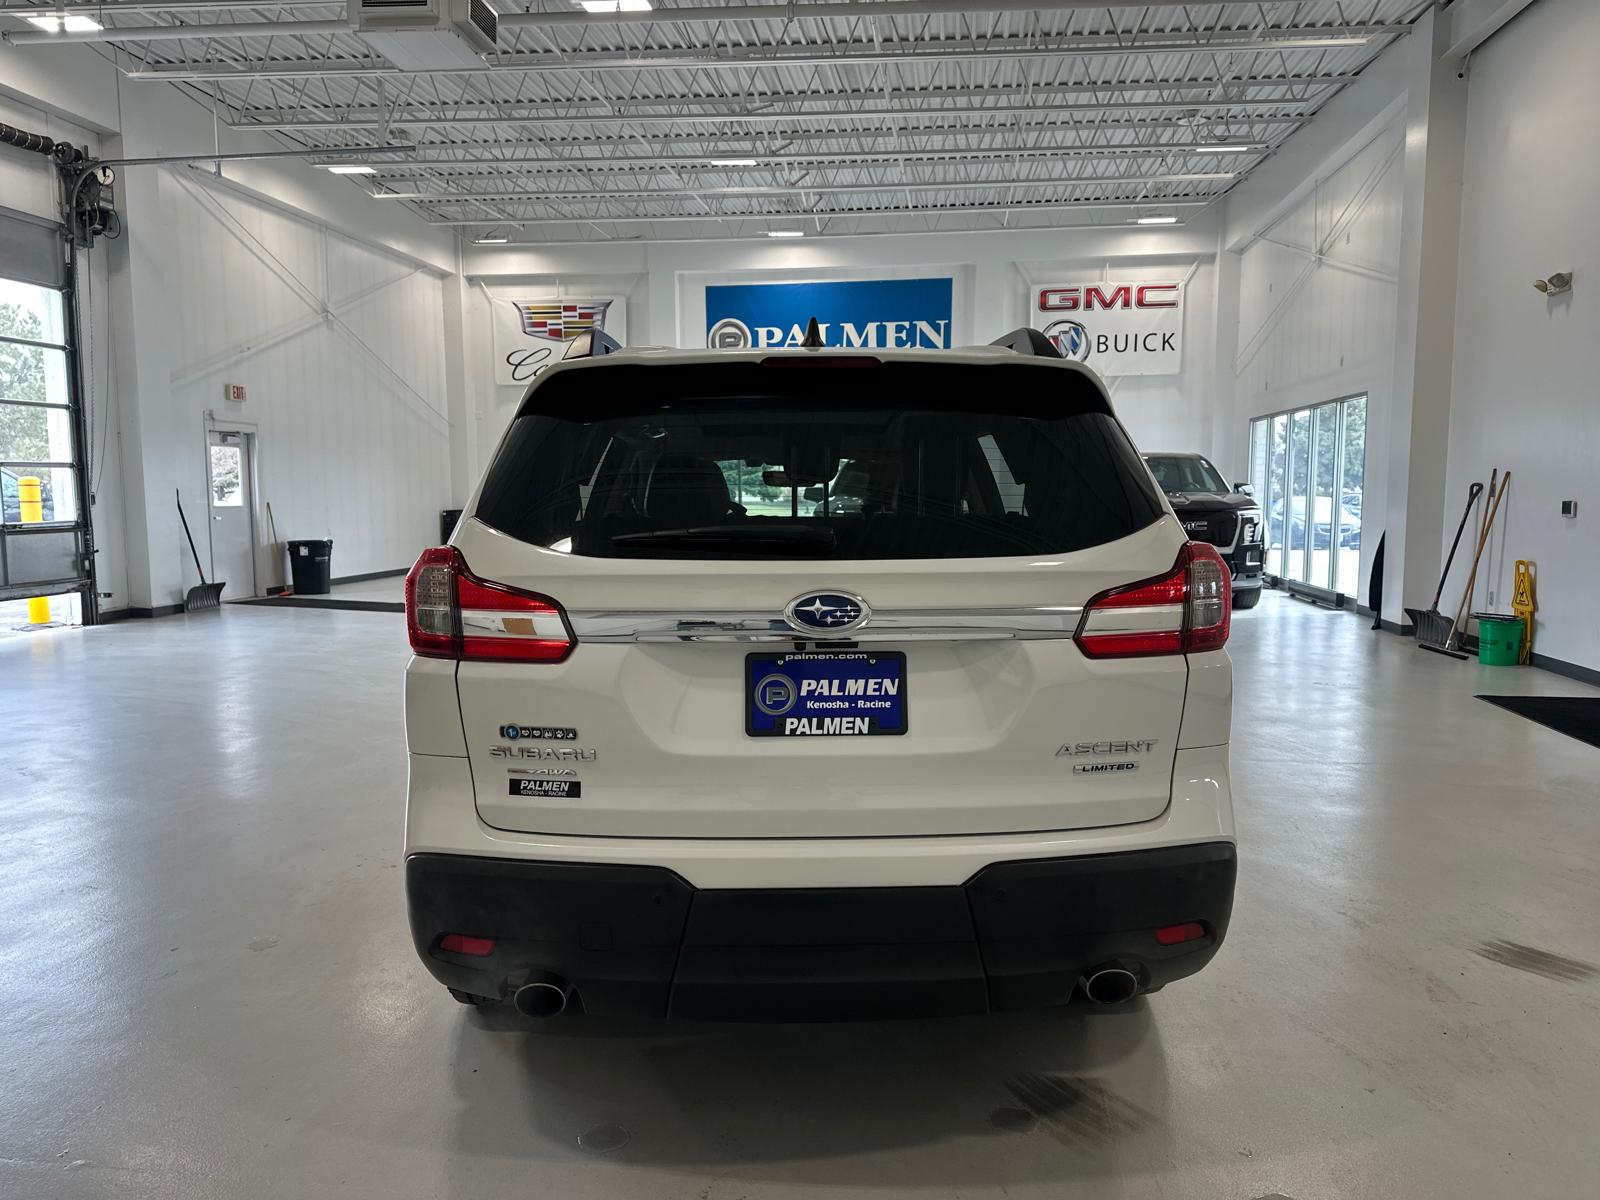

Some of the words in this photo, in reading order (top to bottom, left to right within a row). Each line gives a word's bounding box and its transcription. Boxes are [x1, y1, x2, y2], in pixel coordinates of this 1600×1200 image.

[1038, 283, 1179, 312] GMC
[1096, 332, 1176, 353] BUICK
[1180, 521, 1207, 530] MC
[785, 653, 867, 661] palmen.com
[800, 678, 899, 696] PALMEN
[806, 700, 849, 709] Kenosha
[857, 700, 891, 709] Racine
[785, 717, 869, 735] PALMEN
[488, 745, 597, 762] SUBARU
[1055, 739, 1159, 756] ASCENT
[1082, 763, 1135, 772] LIMITED
[520, 780, 569, 791] PALMEN
